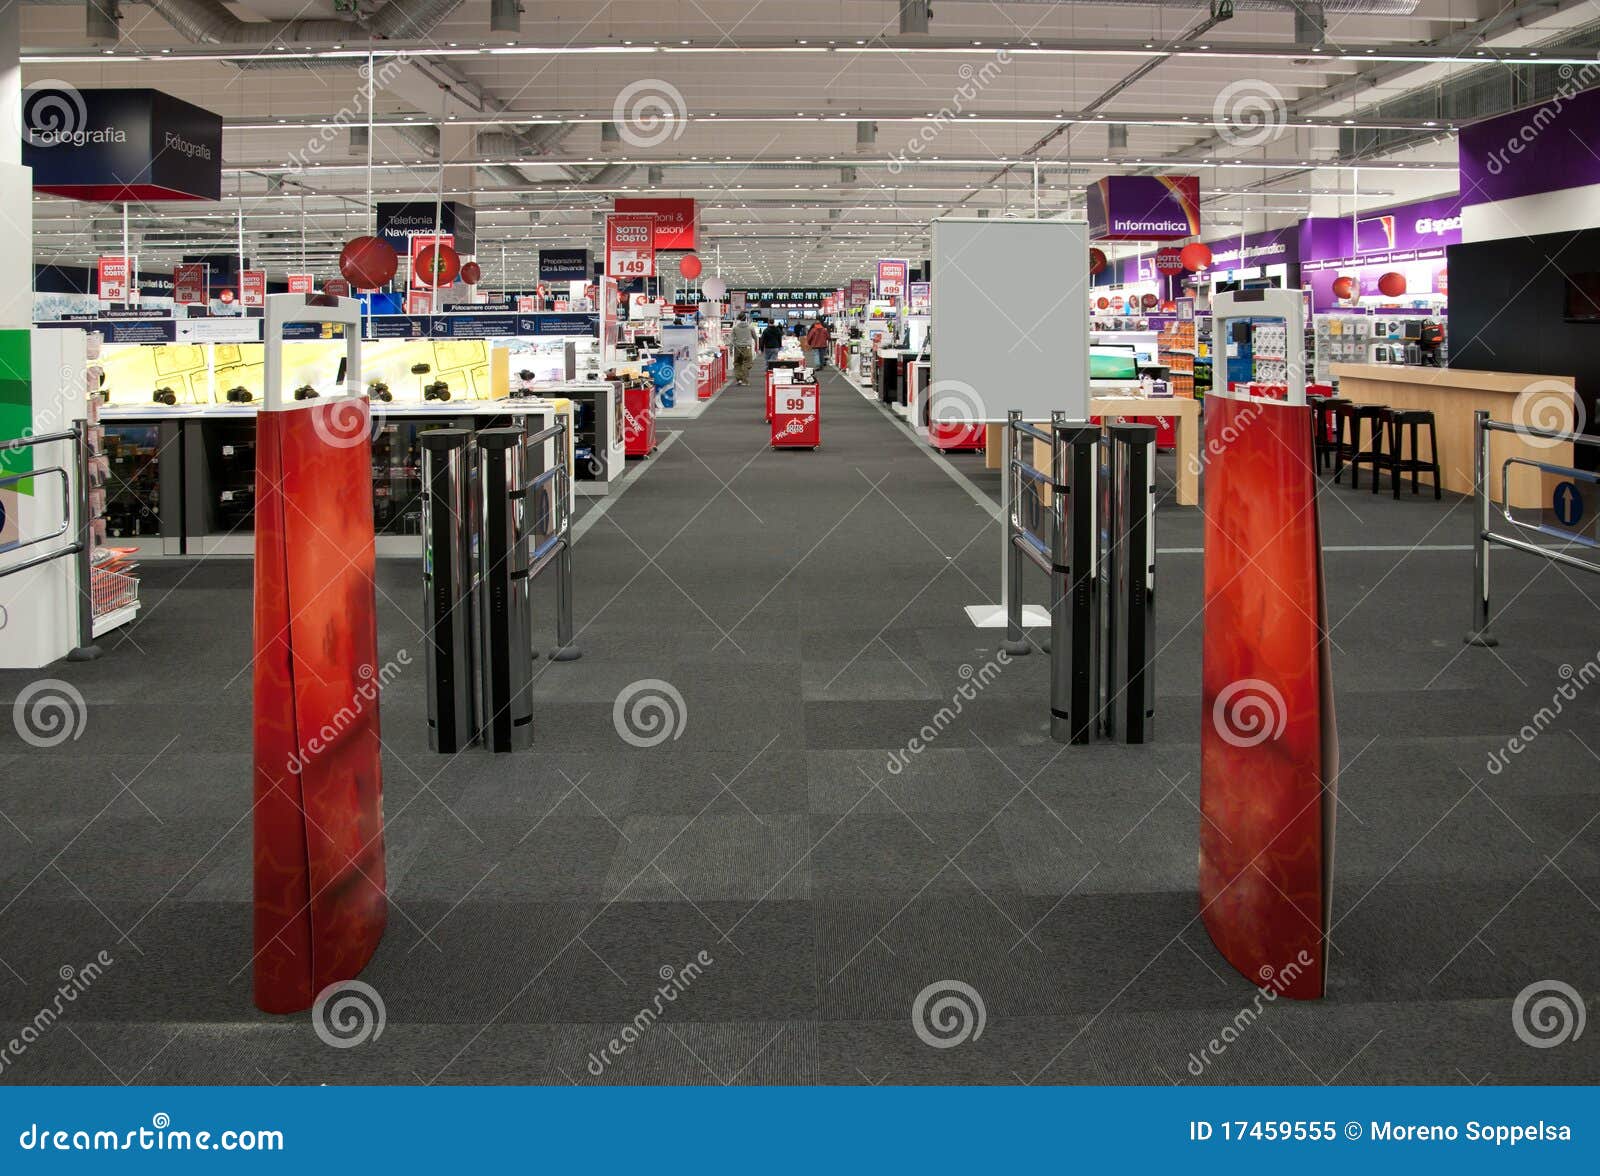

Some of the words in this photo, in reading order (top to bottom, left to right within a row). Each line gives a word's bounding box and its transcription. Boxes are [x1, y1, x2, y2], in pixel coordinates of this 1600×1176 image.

[29, 127, 127, 146] Fotografia
[165, 131, 211, 160] Fotografia
[389, 216, 433, 225] Telefonia
[1114, 219, 1187, 231] Informatica
[385, 227, 447, 237] Navigazioe
[616, 226, 648, 234] SOTTO
[616, 234, 648, 242] COSTO
[617, 261, 645, 273] 149
[108, 288, 120, 297] 99
[884, 286, 900, 294] 499
[786, 398, 805, 410] 99
